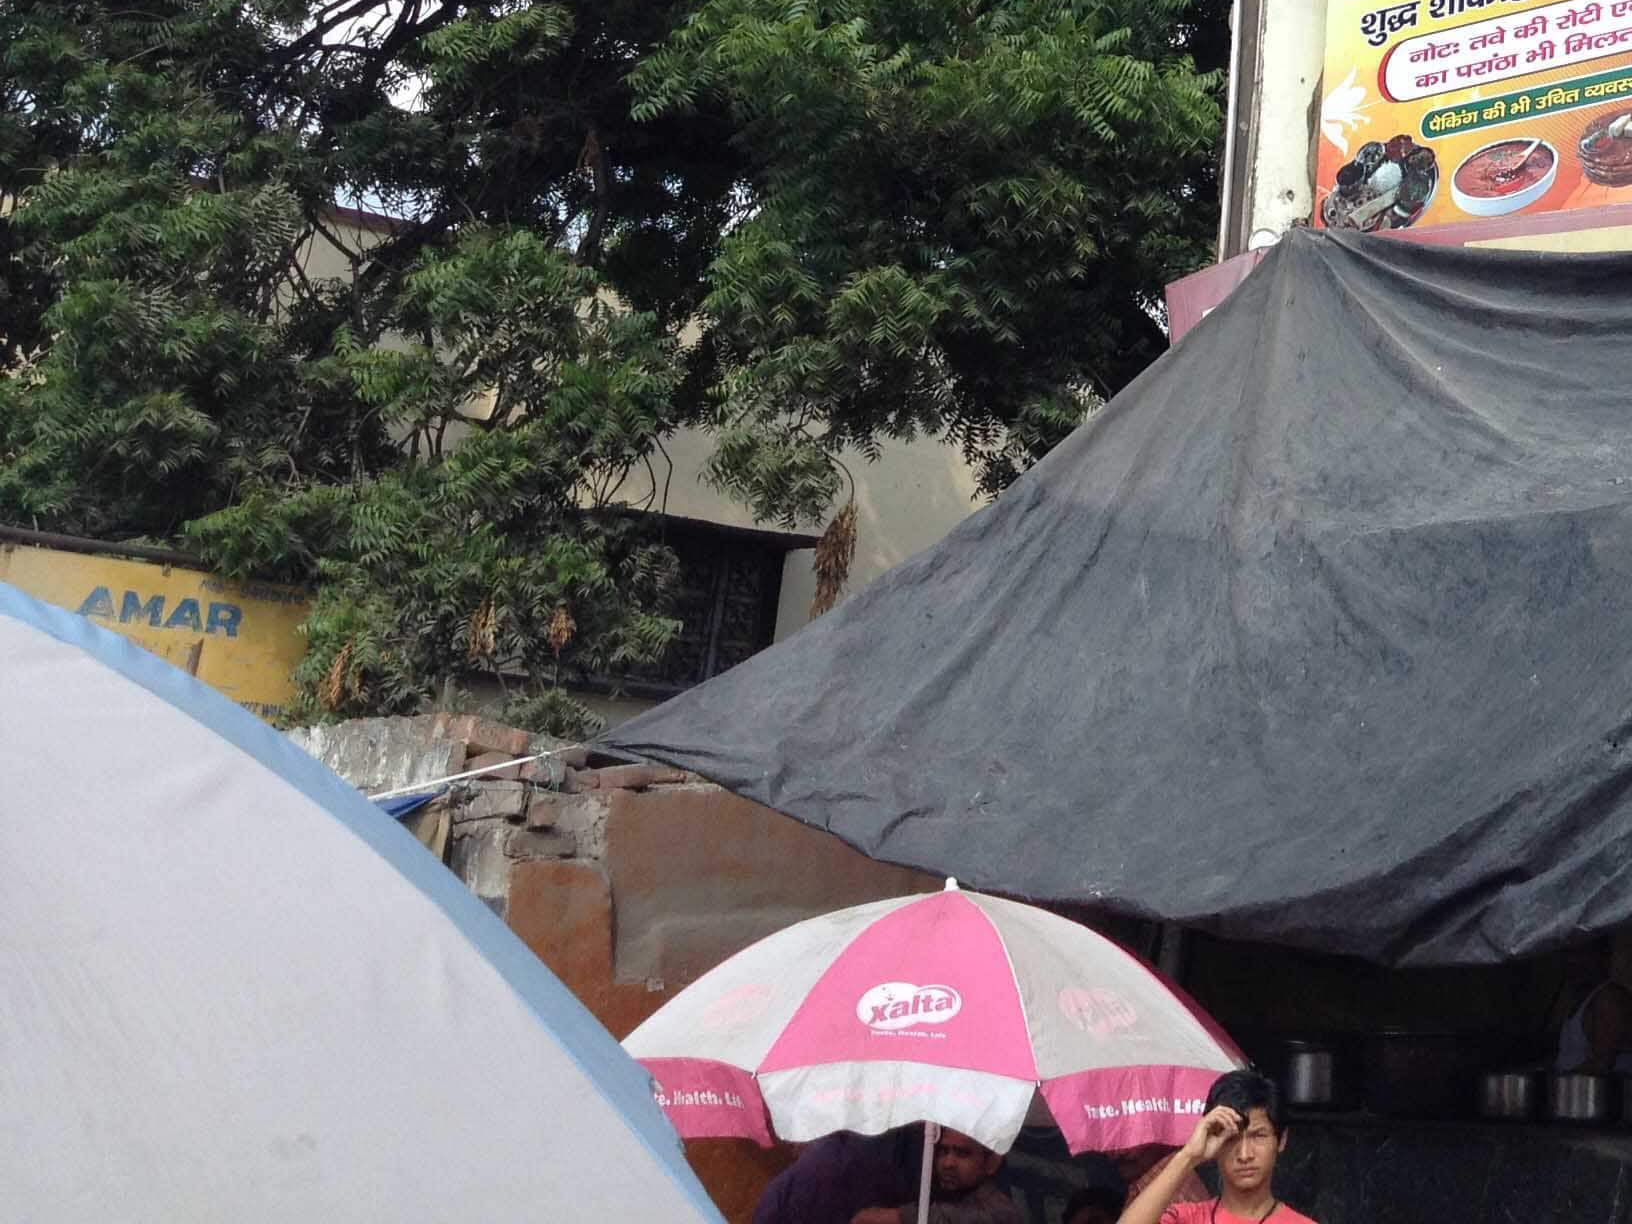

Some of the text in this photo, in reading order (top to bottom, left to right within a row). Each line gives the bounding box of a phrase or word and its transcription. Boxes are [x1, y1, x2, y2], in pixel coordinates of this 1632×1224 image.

[1361, 1, 1420, 46] शुद्ध
[1469, 26, 1506, 51] तवे
[1514, 15, 1549, 39] की
[1556, 2, 1603, 30] रोटी
[1415, 69, 1449, 88] का
[1455, 52, 1519, 78] परांठा
[1525, 40, 1557, 64] भी
[1482, 102, 1506, 121] की
[1509, 95, 1532, 114] भी
[1535, 87, 1580, 110] उचित
[77, 586, 243, 638] AMAR
